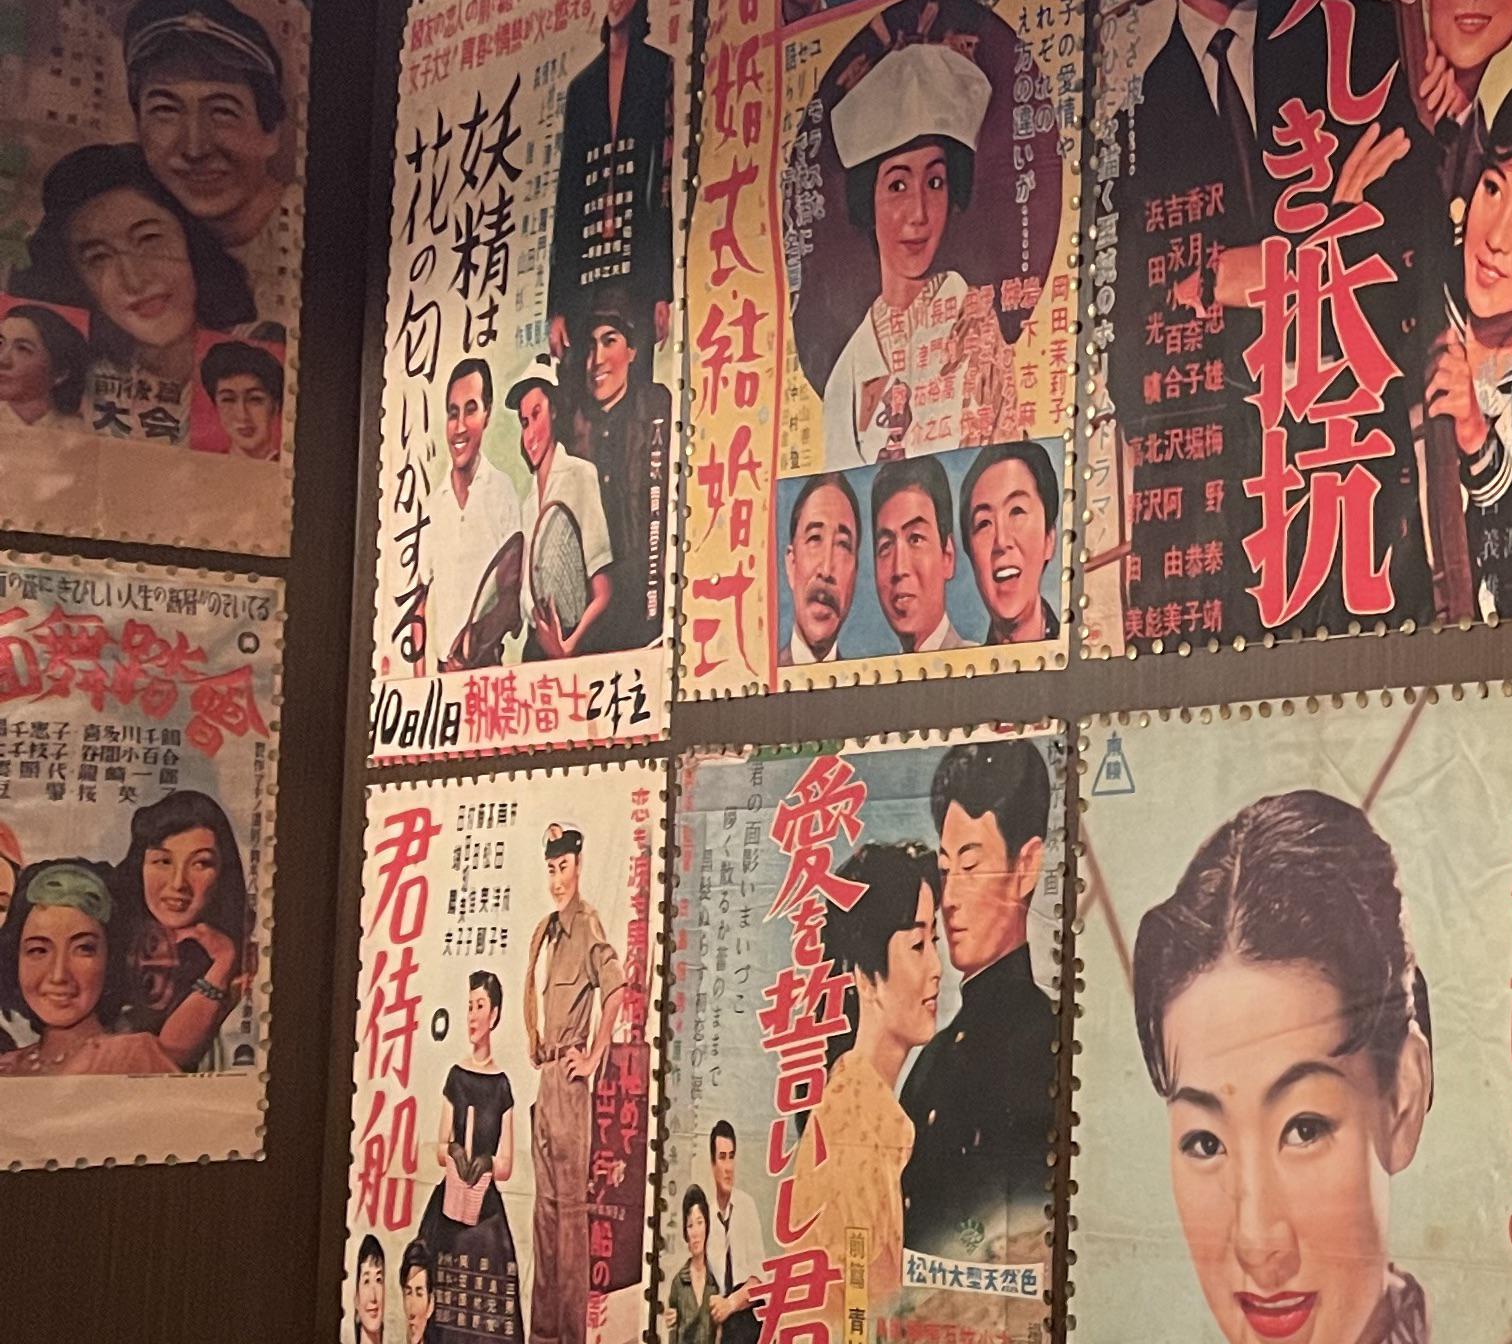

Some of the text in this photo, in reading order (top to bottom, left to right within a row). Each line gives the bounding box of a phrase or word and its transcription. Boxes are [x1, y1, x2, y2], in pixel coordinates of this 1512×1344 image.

[450, 71, 523, 354] 妖精は
[92, 400, 181, 445] 大会
[391, 108, 454, 664] 花の匂いがする
[1048, 273, 1070, 426] 岡田茉莉子
[354, 807, 442, 1231] 君待船
[906, 1254, 1038, 1297] 松竹大型天然色
